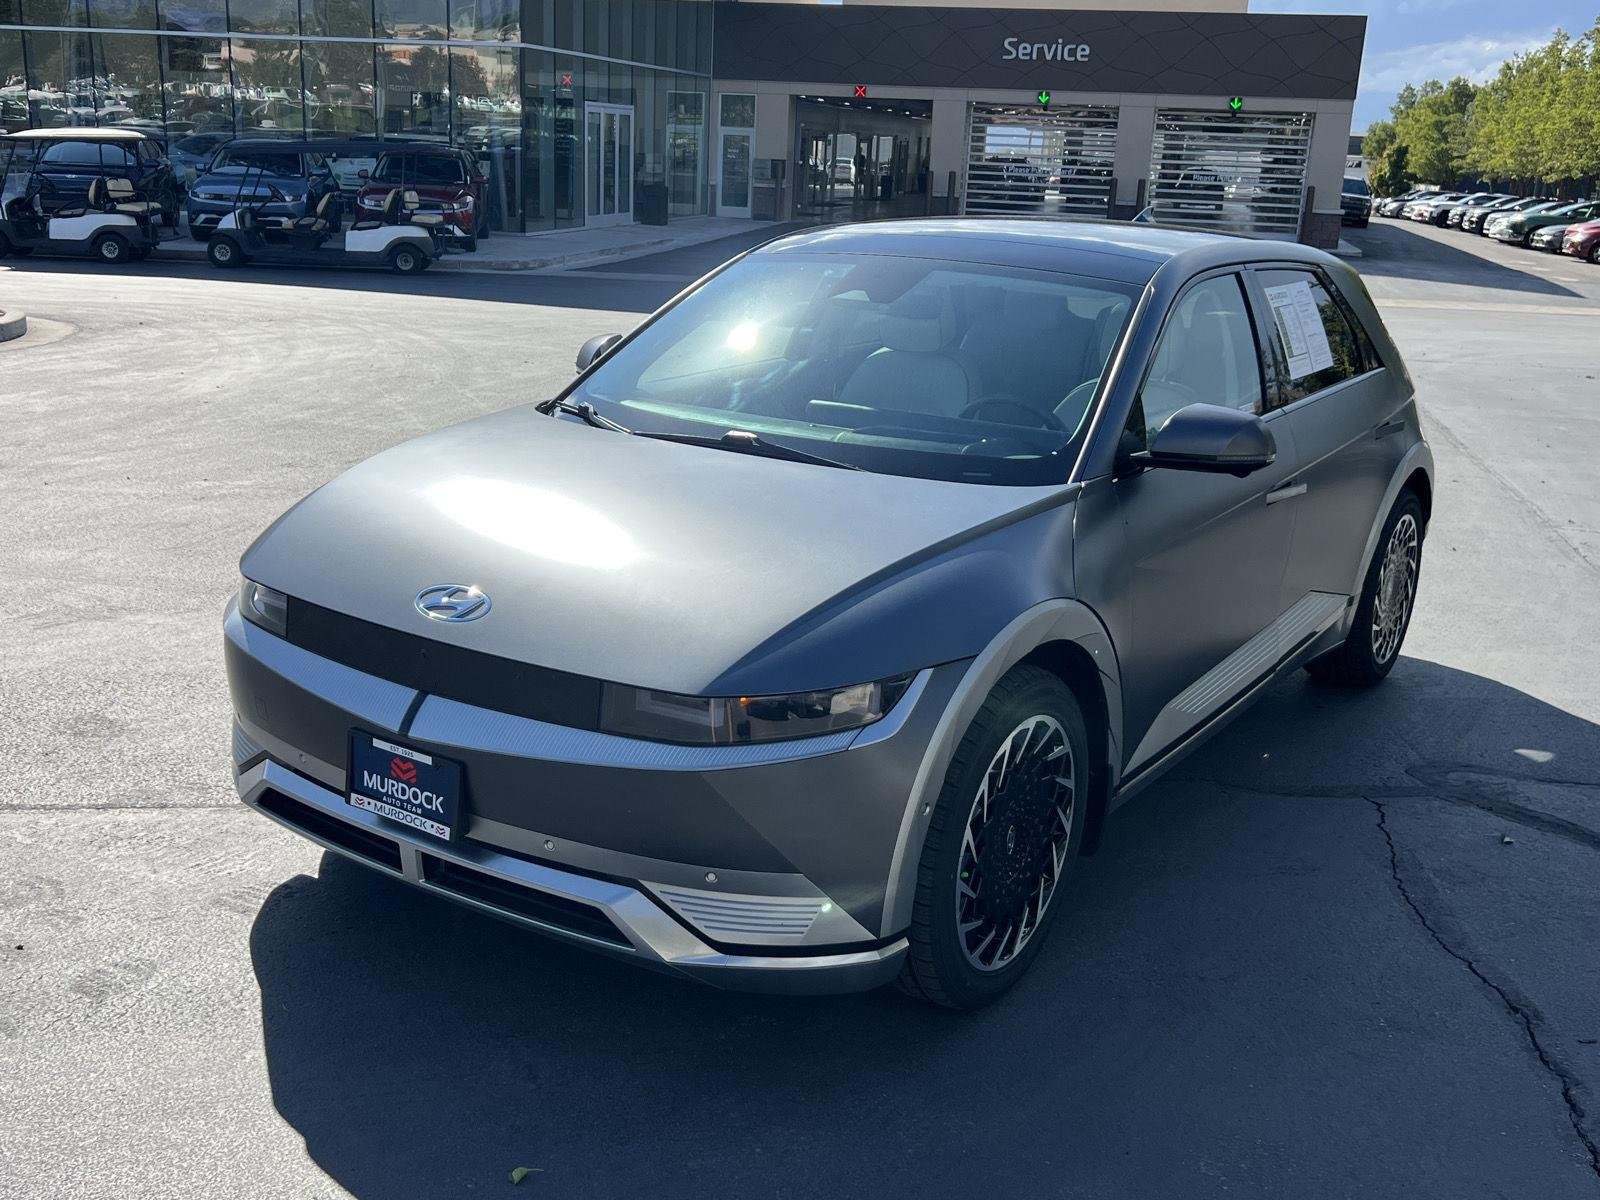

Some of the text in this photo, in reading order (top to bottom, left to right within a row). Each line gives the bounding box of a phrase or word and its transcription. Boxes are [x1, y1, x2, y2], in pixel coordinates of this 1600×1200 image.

[1002, 37, 1090, 62] Service
[363, 770, 444, 814] MURDOCK
[382, 796, 422, 814] AUTO TEAM
[373, 802, 428, 830] MURDOCK
